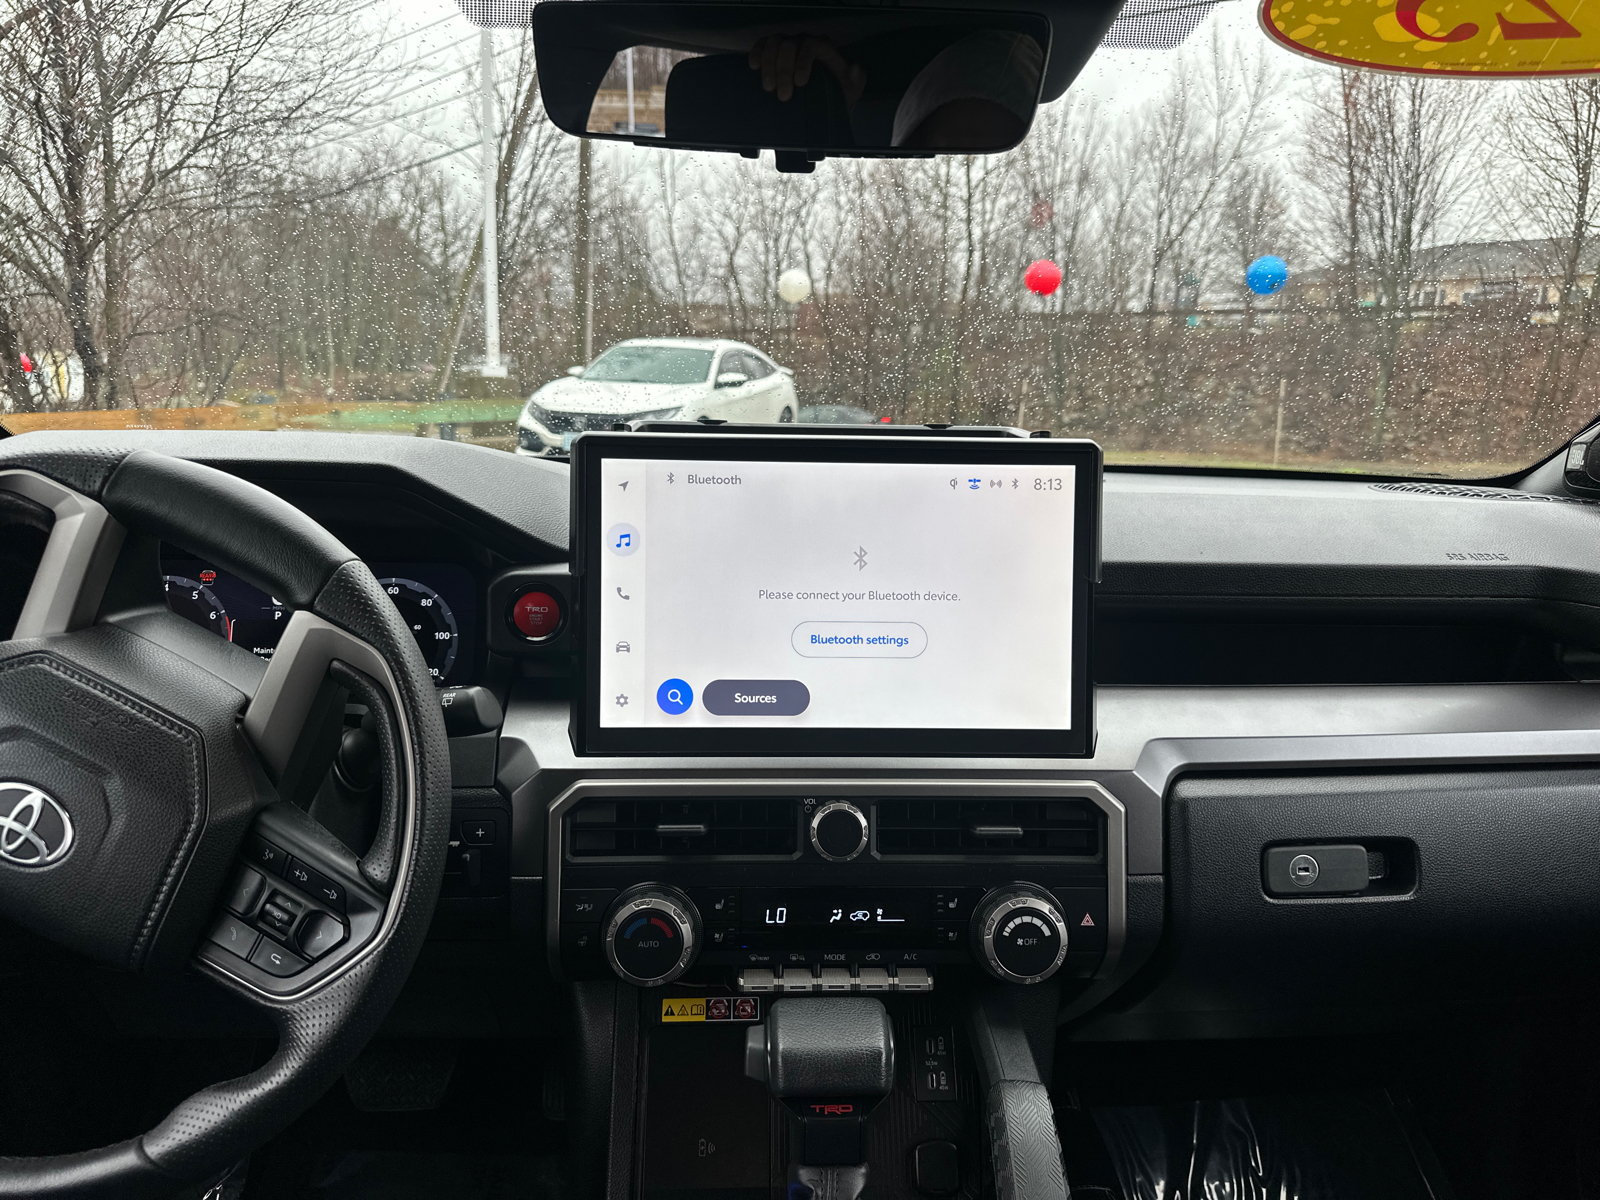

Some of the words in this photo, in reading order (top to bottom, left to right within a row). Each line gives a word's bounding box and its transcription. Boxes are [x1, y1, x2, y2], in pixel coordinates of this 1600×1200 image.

[687, 474, 742, 485] Bluetooth
[1034, 478, 1063, 491] 8:13
[1445, 553, 1467, 561] SRS
[1467, 553, 1510, 561] AIRBAG
[387, 586, 399, 595] 60
[191, 591, 199, 600] 5
[758, 589, 794, 600] Please
[796, 591, 840, 600] connect
[842, 592, 865, 602] your
[868, 590, 921, 601] Bluetooth
[923, 591, 961, 601] device.
[420, 598, 433, 607] 80
[209, 611, 216, 620] 6
[274, 611, 282, 620] P
[434, 631, 450, 640] 100
[810, 634, 864, 645] Bluetooth
[866, 635, 909, 647] settings
[428, 668, 439, 676] 20
[734, 692, 777, 703] Sources
[638, 940, 660, 948] AUTO
[1023, 938, 1038, 946] OFF
[824, 953, 846, 961] MODE
[903, 953, 918, 961] A/C
[810, 1104, 854, 1115] TRD
